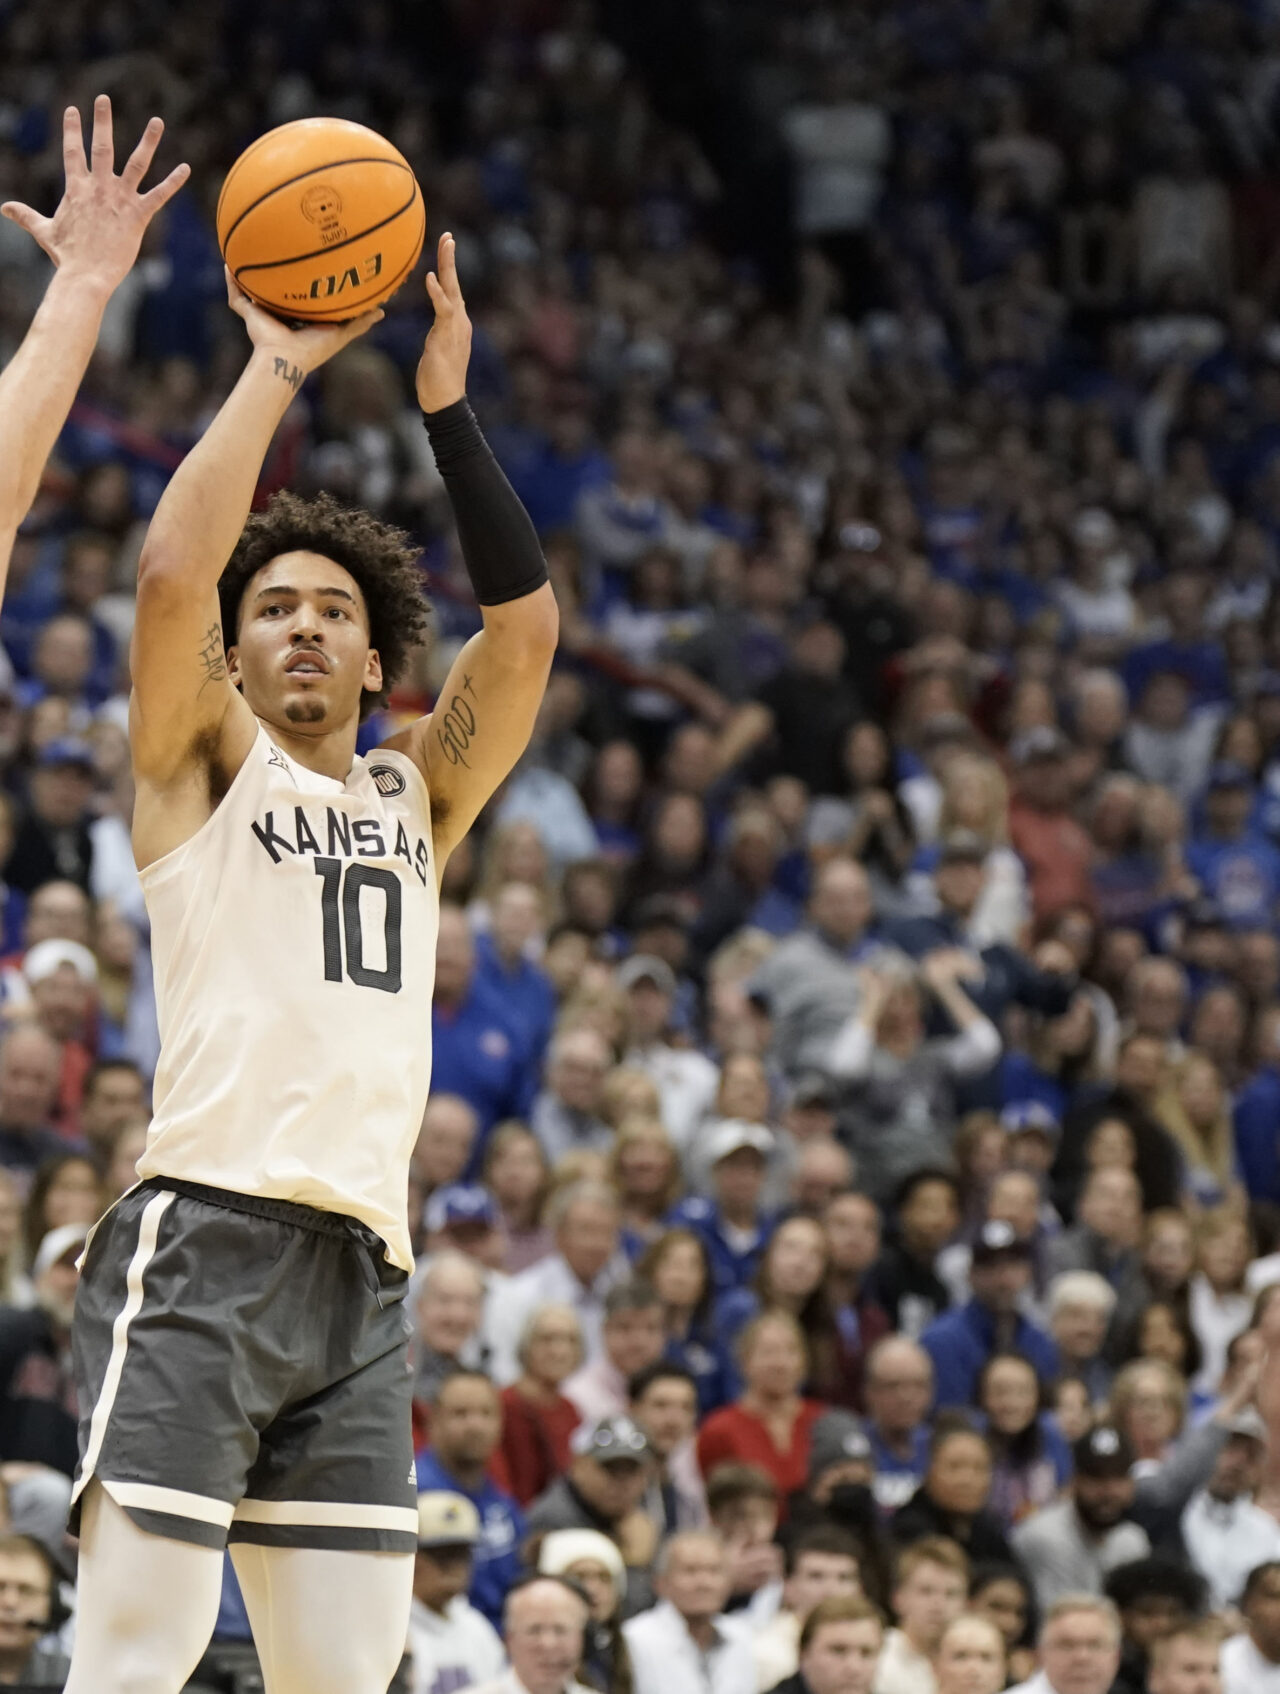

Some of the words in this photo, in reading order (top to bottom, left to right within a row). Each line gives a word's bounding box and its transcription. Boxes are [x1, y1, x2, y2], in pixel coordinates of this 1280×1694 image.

[309, 253, 382, 300] EVO
[437, 695, 475, 769] GOD
[251, 806, 428, 887] KANSAS
[314, 856, 403, 994] 10
